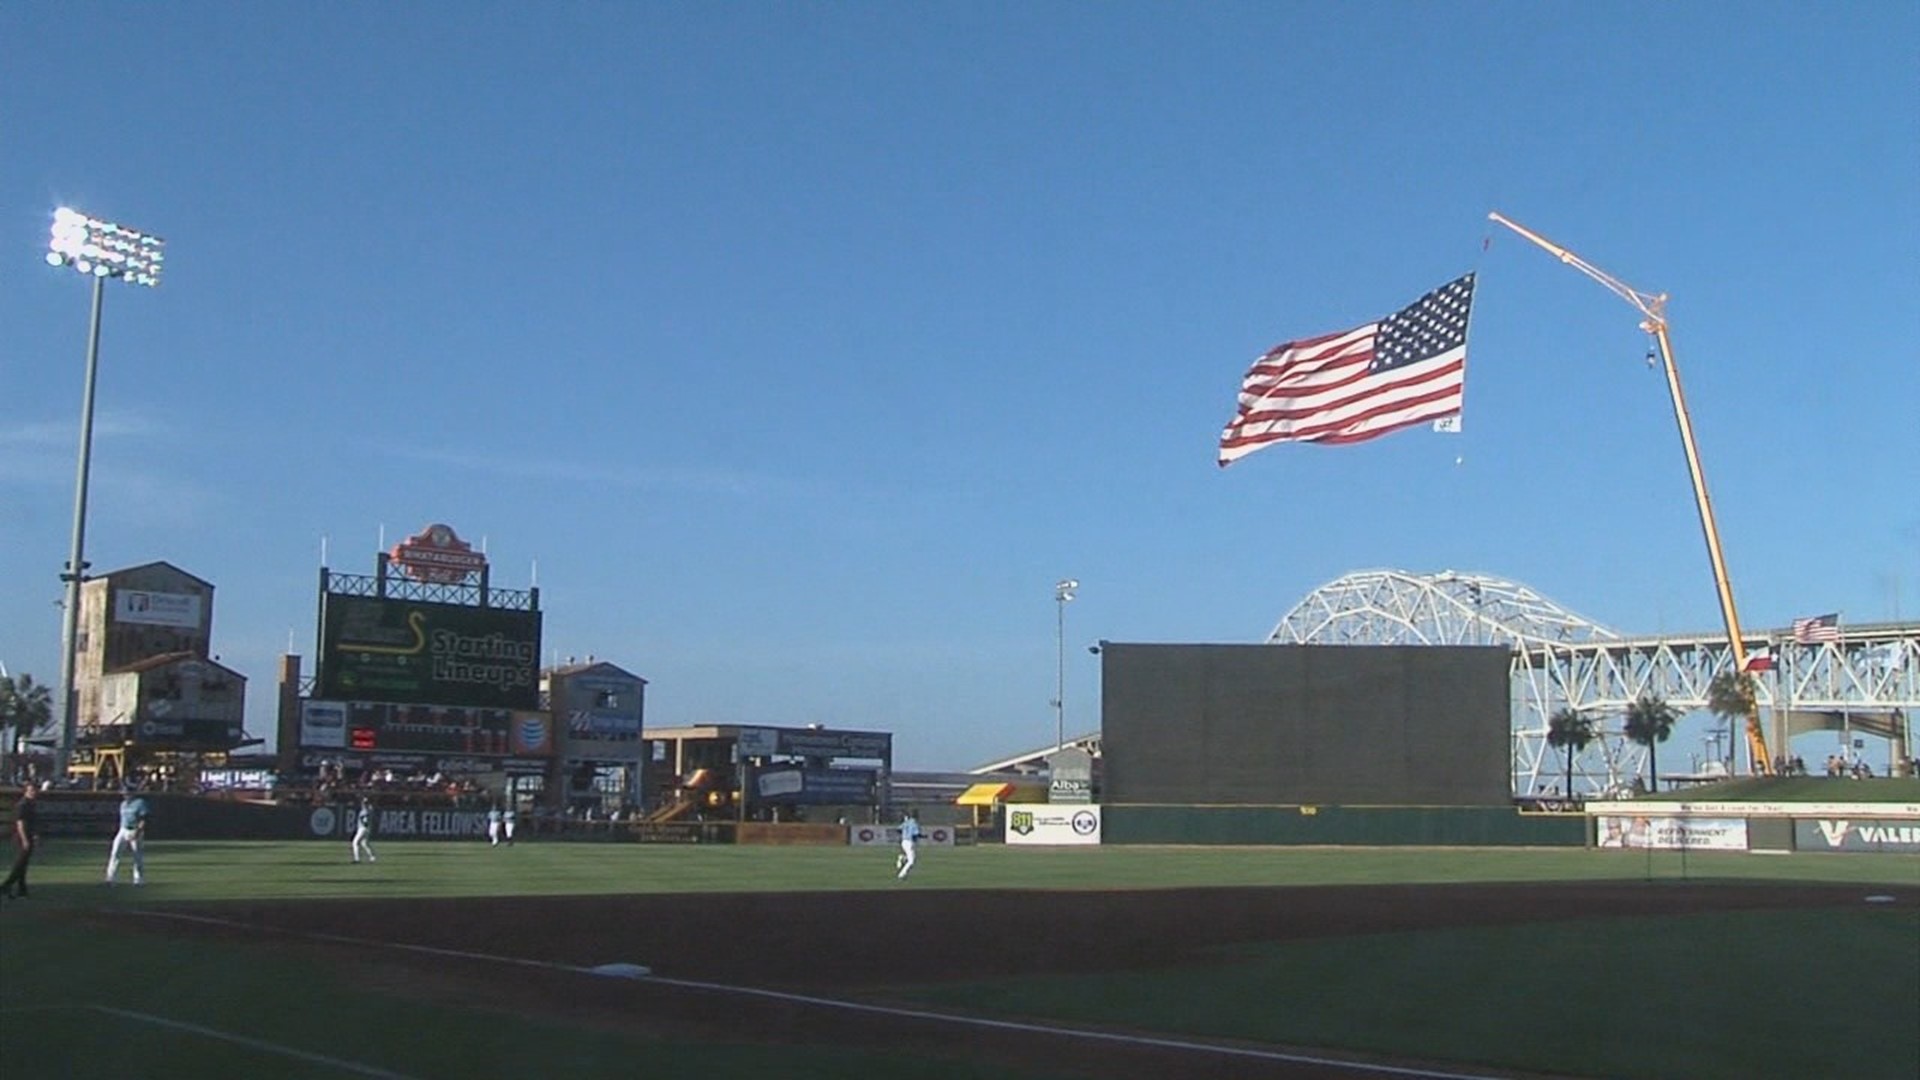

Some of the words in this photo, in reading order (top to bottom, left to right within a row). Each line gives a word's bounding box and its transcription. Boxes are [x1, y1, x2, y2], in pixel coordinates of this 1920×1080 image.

[431, 629, 535, 666] Starting
[431, 655, 532, 691] Lineups
[1052, 780, 1080, 790] Alba
[379, 810, 417, 834] AREA
[421, 810, 490, 835] FELLOWS
[1012, 811, 1032, 827] 811
